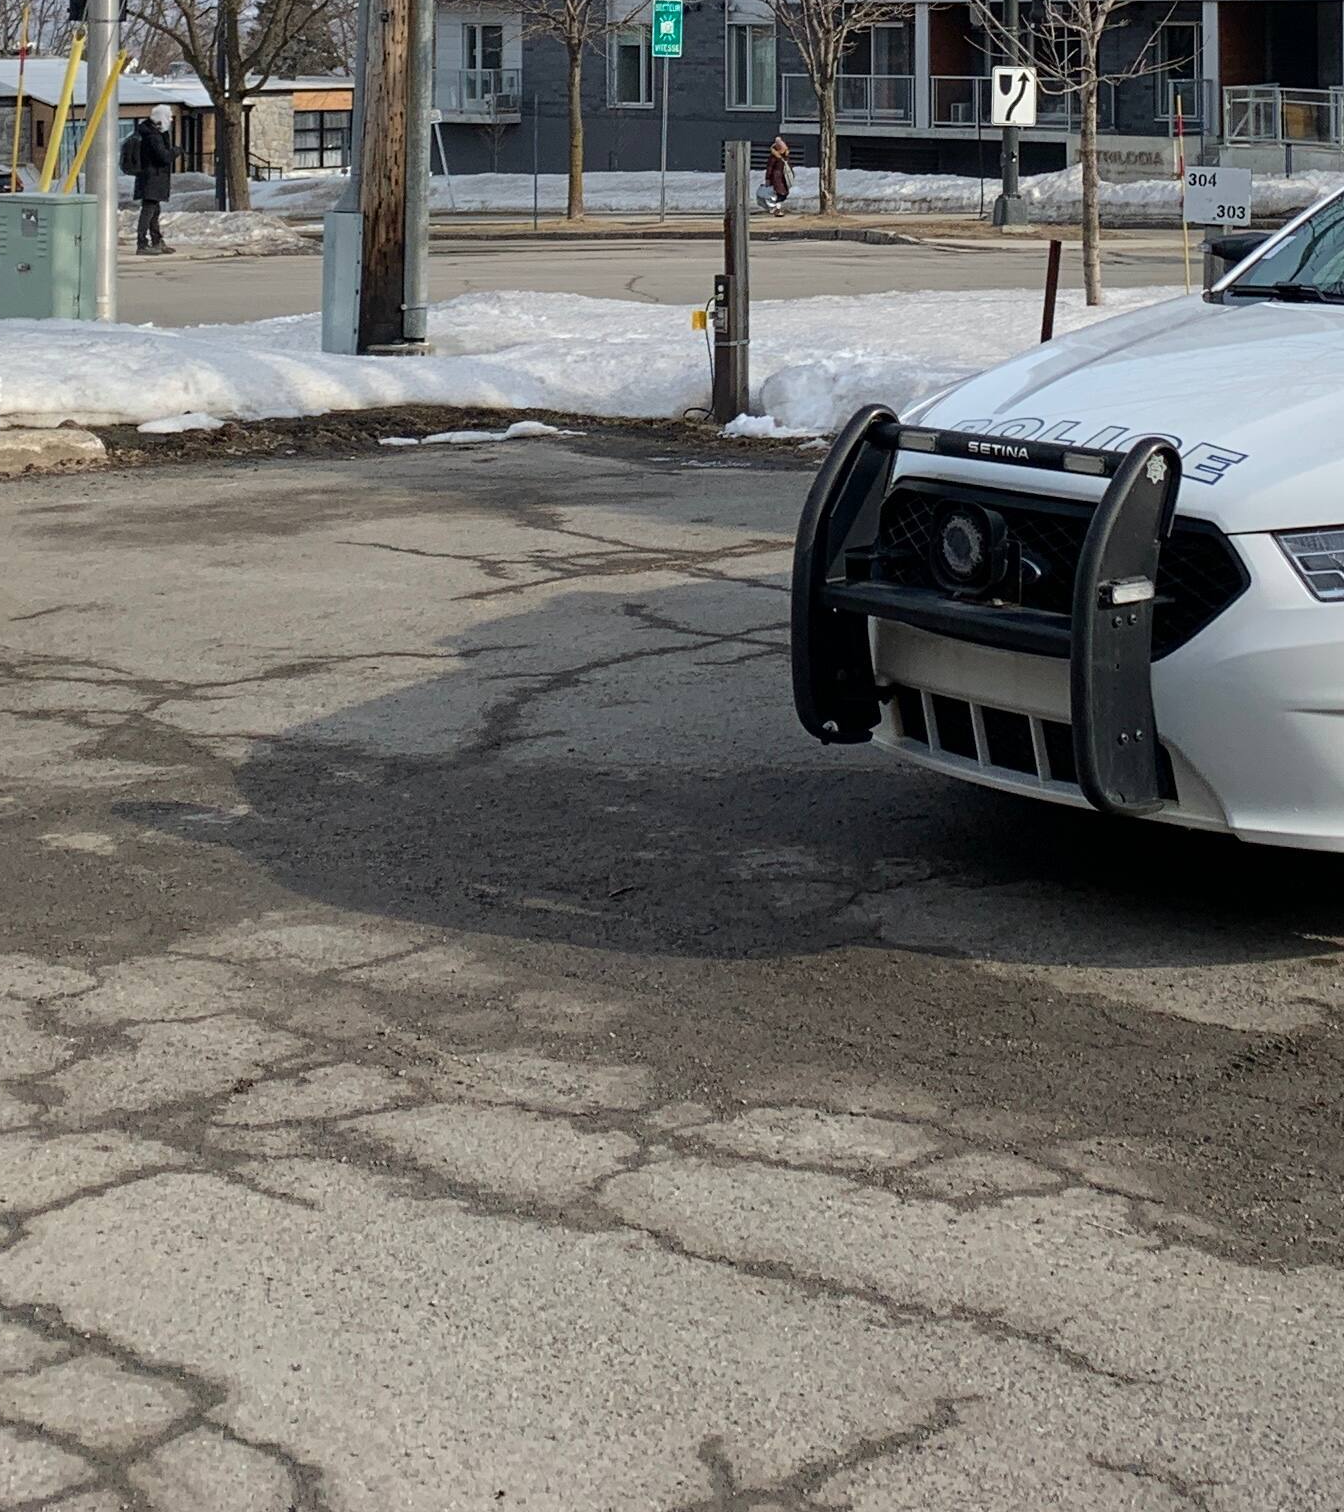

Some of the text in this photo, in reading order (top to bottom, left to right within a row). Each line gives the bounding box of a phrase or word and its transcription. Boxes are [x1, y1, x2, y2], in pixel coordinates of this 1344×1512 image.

[1188, 172, 1217, 187] 304
[1216, 205, 1246, 219] 303
[968, 441, 1029, 459] SETINA
